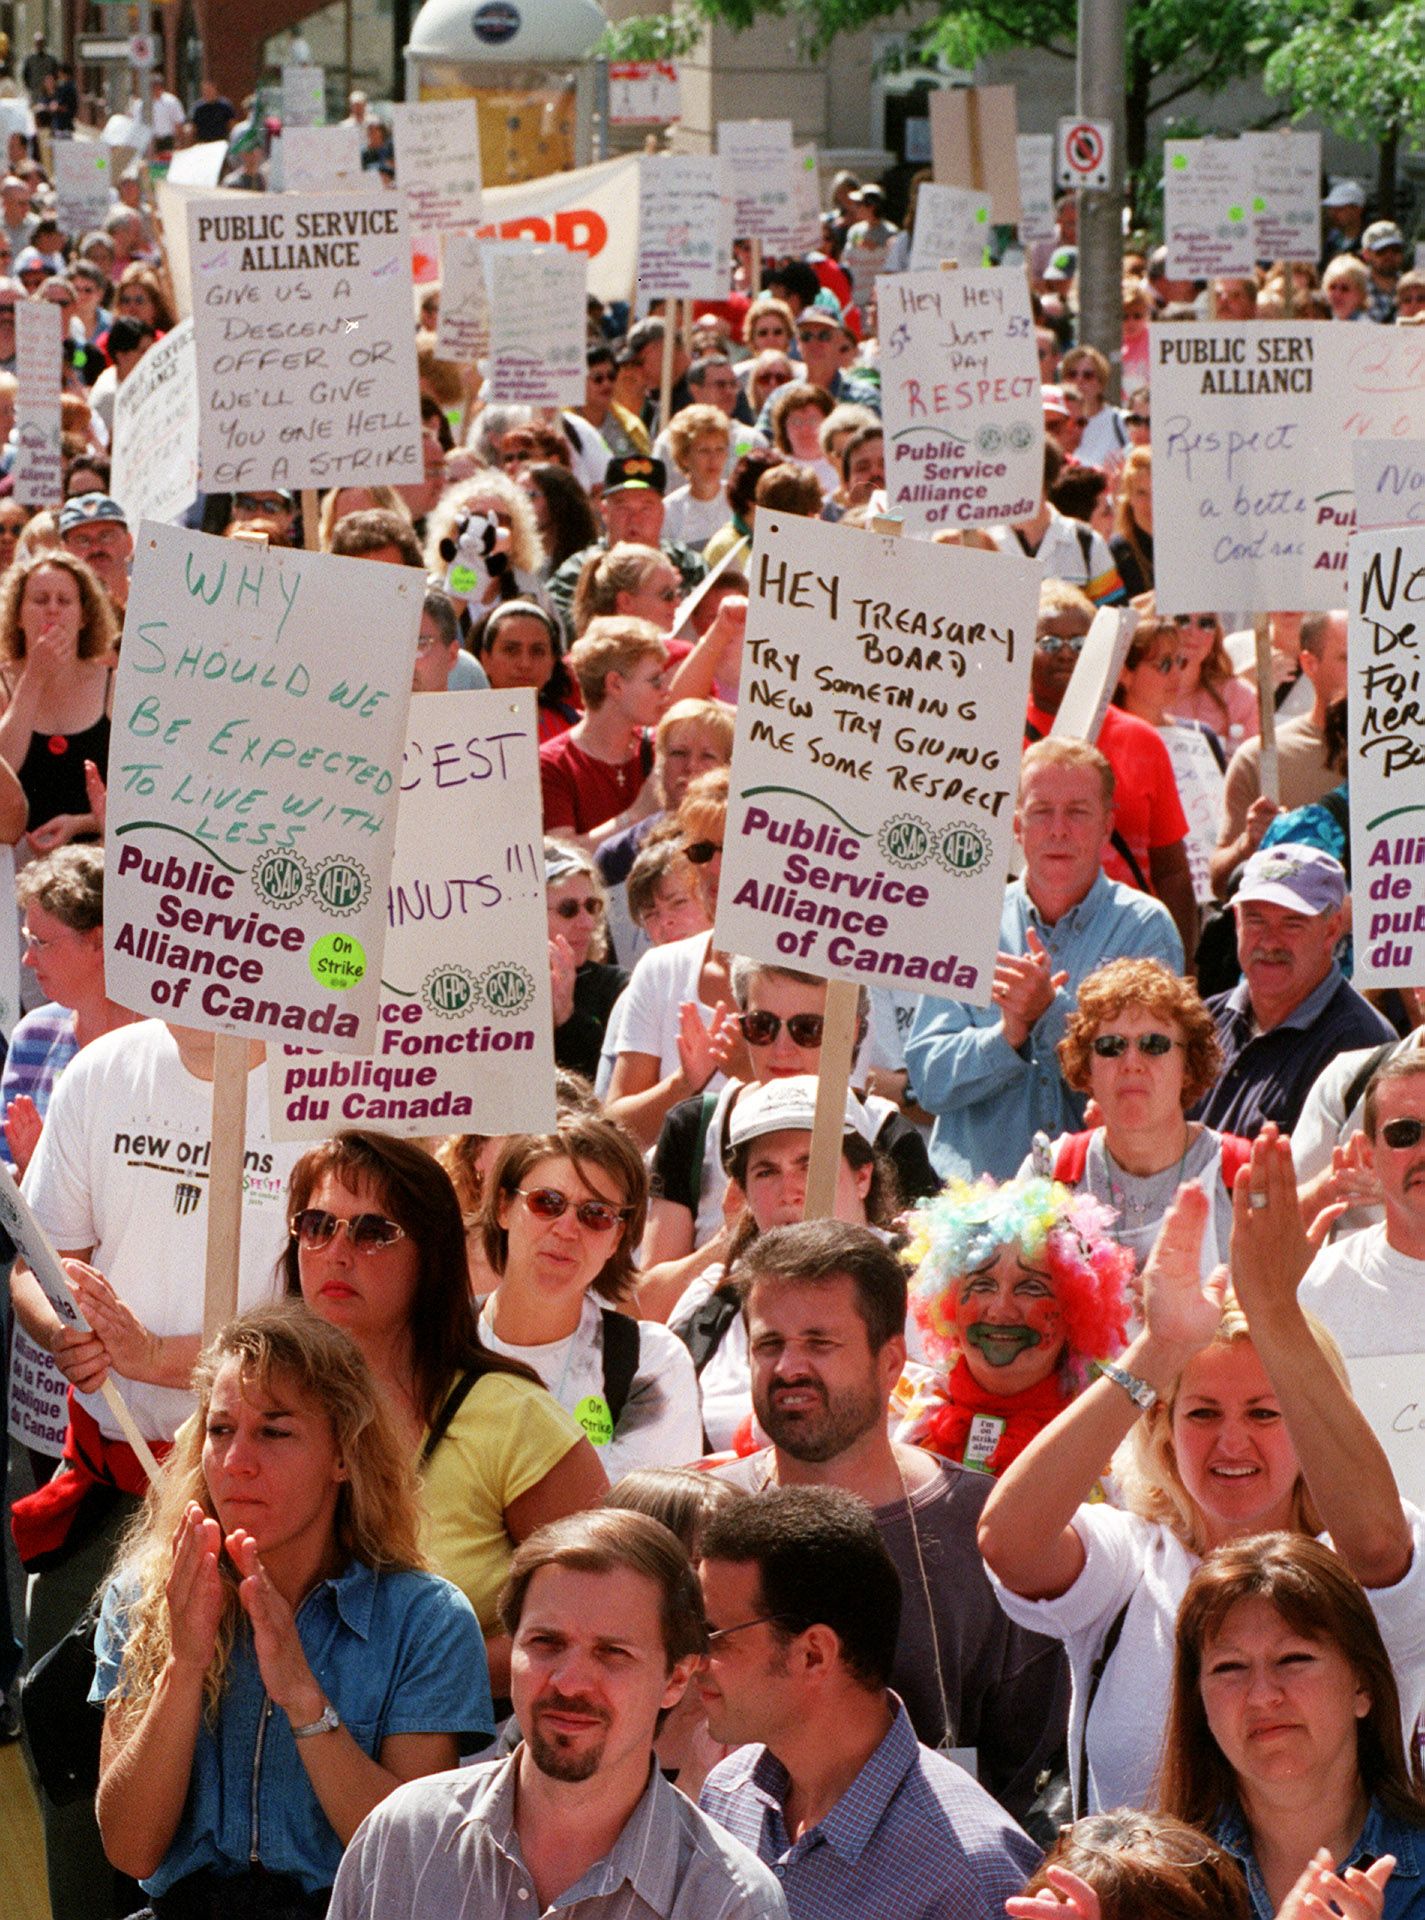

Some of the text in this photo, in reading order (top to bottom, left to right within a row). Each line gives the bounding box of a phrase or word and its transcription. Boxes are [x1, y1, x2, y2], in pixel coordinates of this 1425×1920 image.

[199, 209, 399, 242] PUBLIC SERVICE
[241, 242, 360, 271] ALLIANCE
[206, 279, 351, 306] GIVE US A
[214, 342, 395, 374] OFFER OR
[1160, 338, 1246, 364] PUBLIC
[211, 377, 376, 411] WE'LL GIVE
[901, 376, 1039, 418] RESPECT
[219, 410, 410, 449] YOU ONE HELL
[1164, 415, 1298, 482] Respect
[271, 456, 289, 481] A
[310, 445, 418, 476] STRIKE
[895, 440, 966, 462] Public
[924, 460, 1007, 482] Service
[897, 484, 988, 503] Alliance
[925, 499, 1034, 523] of Canada
[185, 551, 302, 644] WHY
[760, 553, 839, 620] HEY
[853, 599, 1014, 662] TREASURY
[132, 621, 390, 718] SHOULD WE
[856, 633, 967, 678] BOARD
[747, 639, 977, 721] TRY SOMETHING
[750, 679, 813, 717] NEW
[834, 709, 882, 743] TRY
[128, 695, 394, 795] BE EXPECTED
[750, 720, 1011, 817] ME SOME RESPECT
[121, 763, 385, 837] TO LIVE WITH
[195, 816, 307, 848] LESS
[742, 806, 860, 860] Public
[891, 824, 981, 866] PSAC AFPC
[117, 844, 235, 900] Public
[264, 860, 359, 905] PSAC AFPC
[783, 853, 930, 907] Service
[1369, 873, 1412, 901] de
[156, 894, 306, 952] Service
[732, 878, 889, 937] Alliance
[113, 922, 264, 984] Alliance
[333, 936, 352, 954] On
[776, 930, 979, 989] of Canada
[1371, 940, 1413, 968] du
[317, 957, 364, 977] Strike
[150, 977, 361, 1039] of Canada
[435, 971, 525, 1009] AFPC PSAC
[382, 1026, 535, 1055] Fonction
[284, 1060, 438, 1094] publique
[286, 1091, 473, 1121] du Canada
[114, 1133, 273, 1174] new orlns
